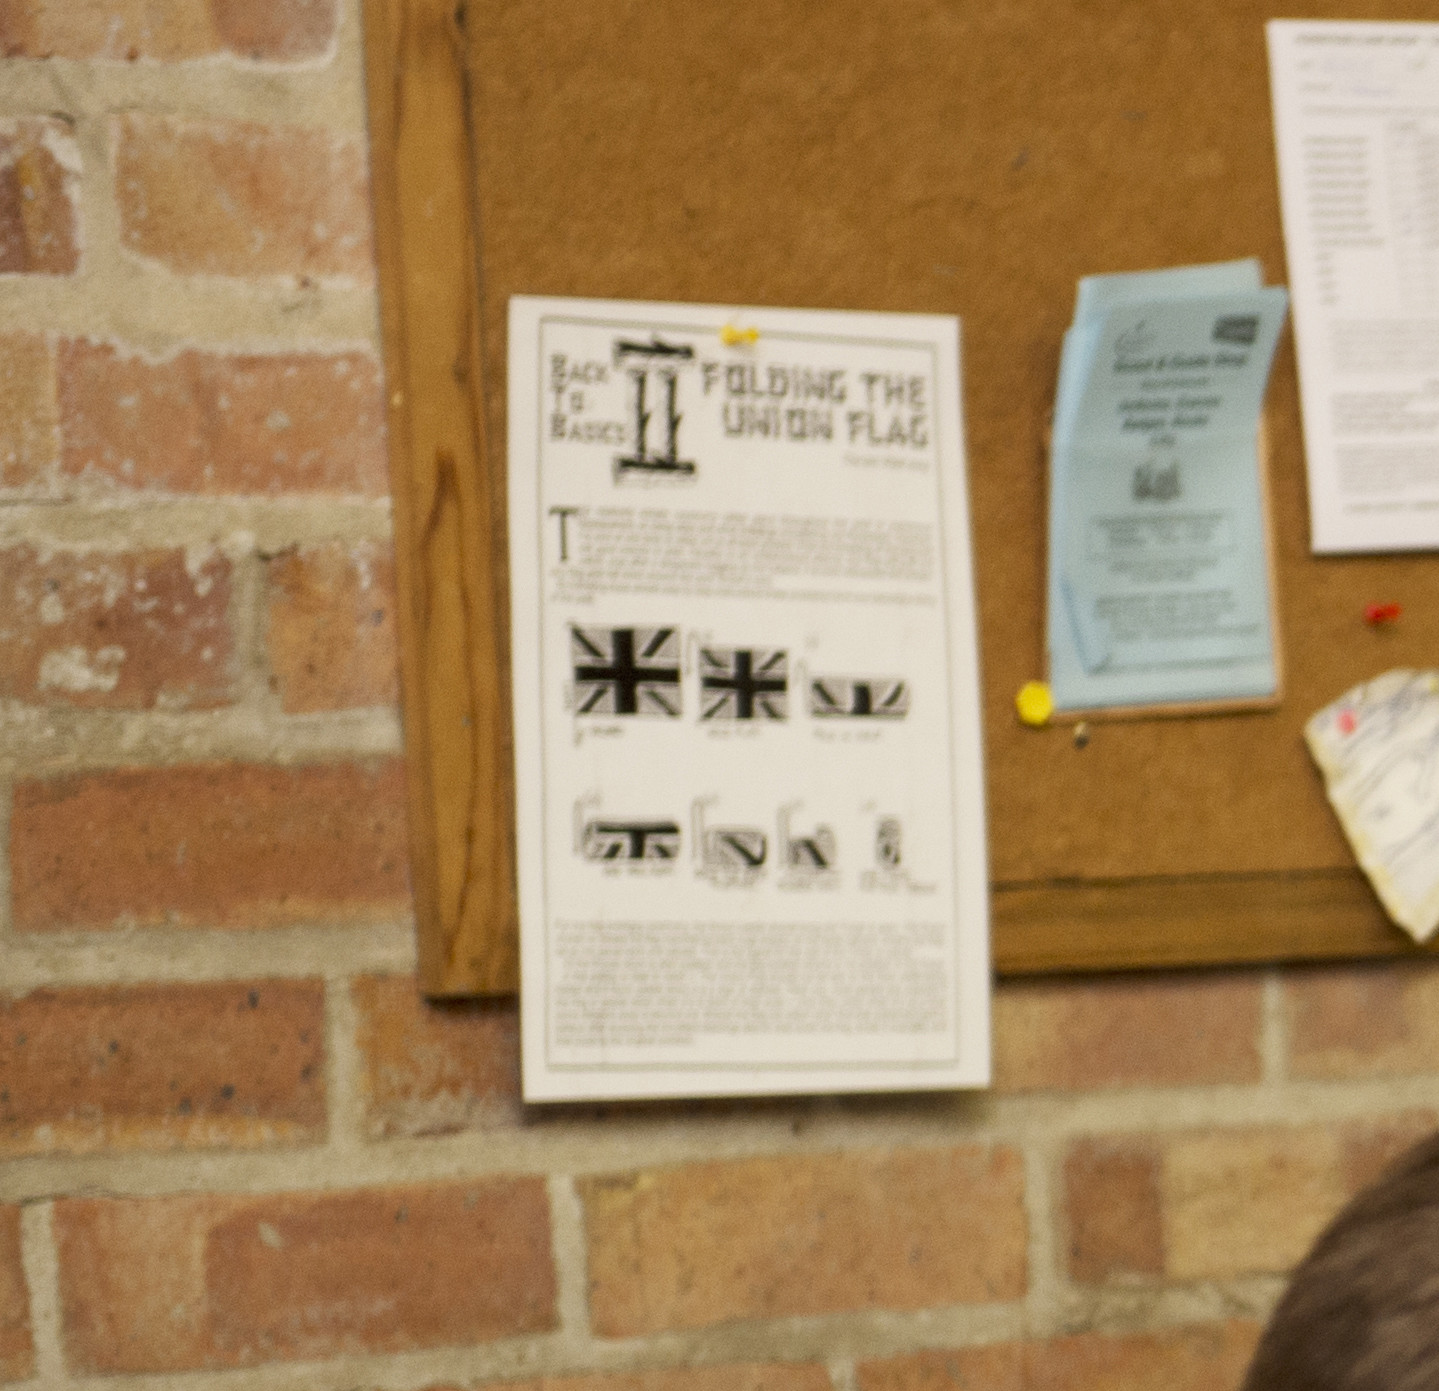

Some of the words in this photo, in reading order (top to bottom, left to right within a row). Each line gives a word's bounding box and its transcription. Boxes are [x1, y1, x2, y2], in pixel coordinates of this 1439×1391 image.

[701, 362, 846, 402] FOLDING
[859, 372, 926, 409] THE
[722, 403, 833, 441] UNION
[847, 411, 928, 448] FLAG
